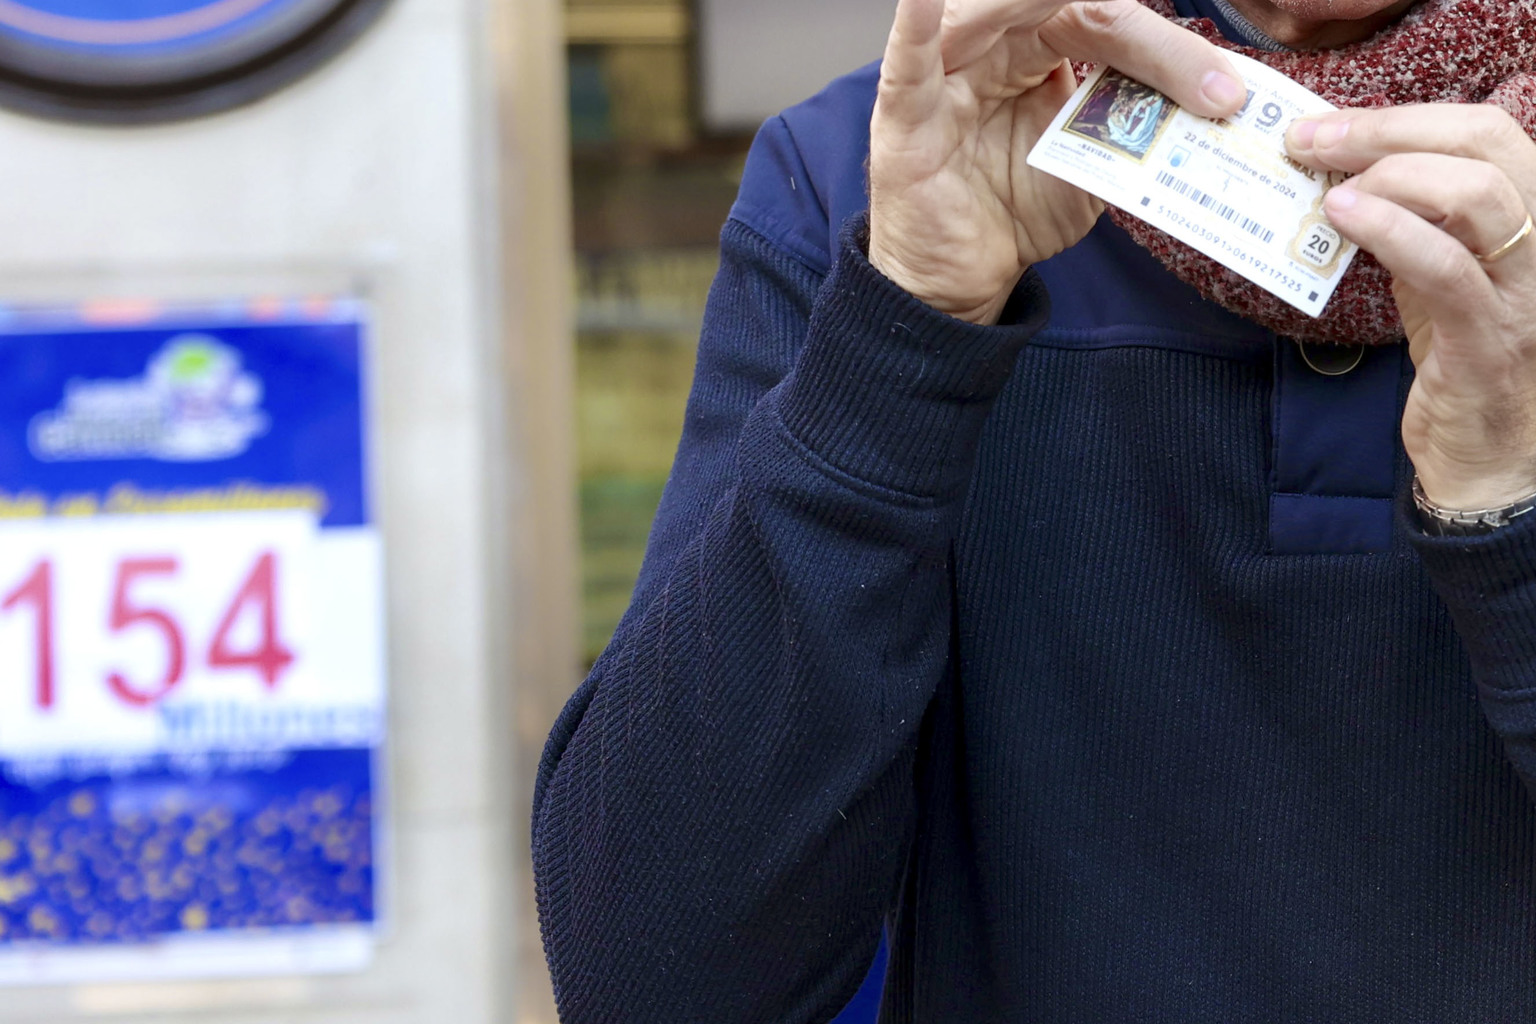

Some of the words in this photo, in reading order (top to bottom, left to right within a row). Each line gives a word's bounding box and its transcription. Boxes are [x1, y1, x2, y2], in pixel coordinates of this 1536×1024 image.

[1183, 131, 1197, 144] 22
[1196, 138, 1211, 151] de
[1210, 145, 1259, 177] diciembre
[1257, 171, 1273, 186] de
[1272, 180, 1297, 200] 2024
[1302, 250, 1323, 263] EUROS
[1307, 234, 1330, 254] 20
[0, 550, 297, 711] 154
